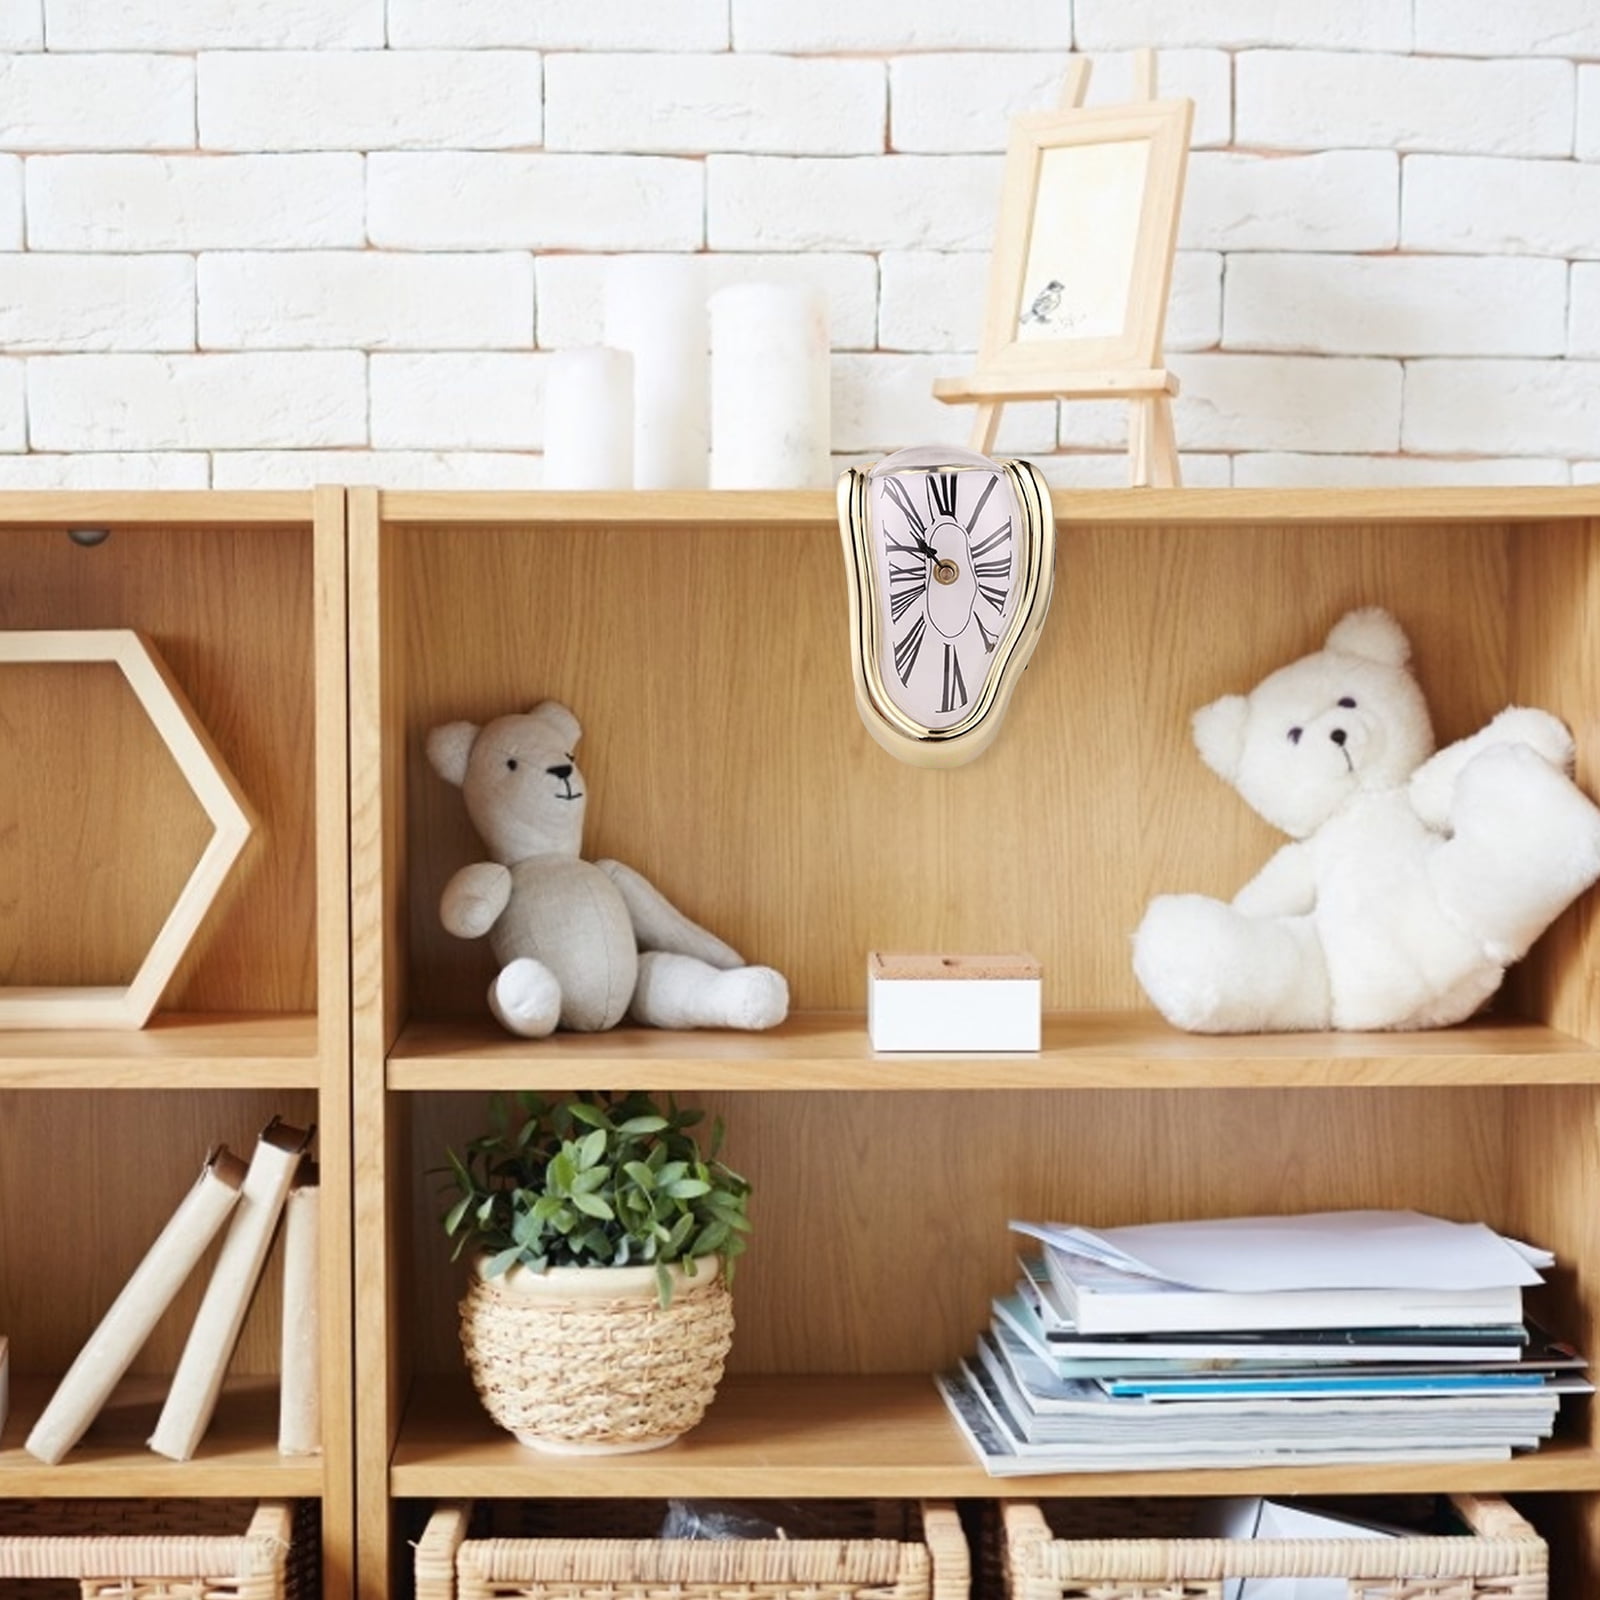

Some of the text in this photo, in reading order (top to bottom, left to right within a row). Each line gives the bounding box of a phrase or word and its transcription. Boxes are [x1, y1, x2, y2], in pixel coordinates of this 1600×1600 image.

[962, 473, 1001, 539] I
[882, 519, 927, 564] X
[968, 515, 1012, 561] II
[889, 560, 927, 587] IX
[973, 550, 1012, 580] III
[889, 580, 927, 625] VIII
[892, 610, 927, 689] VII
[935, 641, 968, 713] VI
